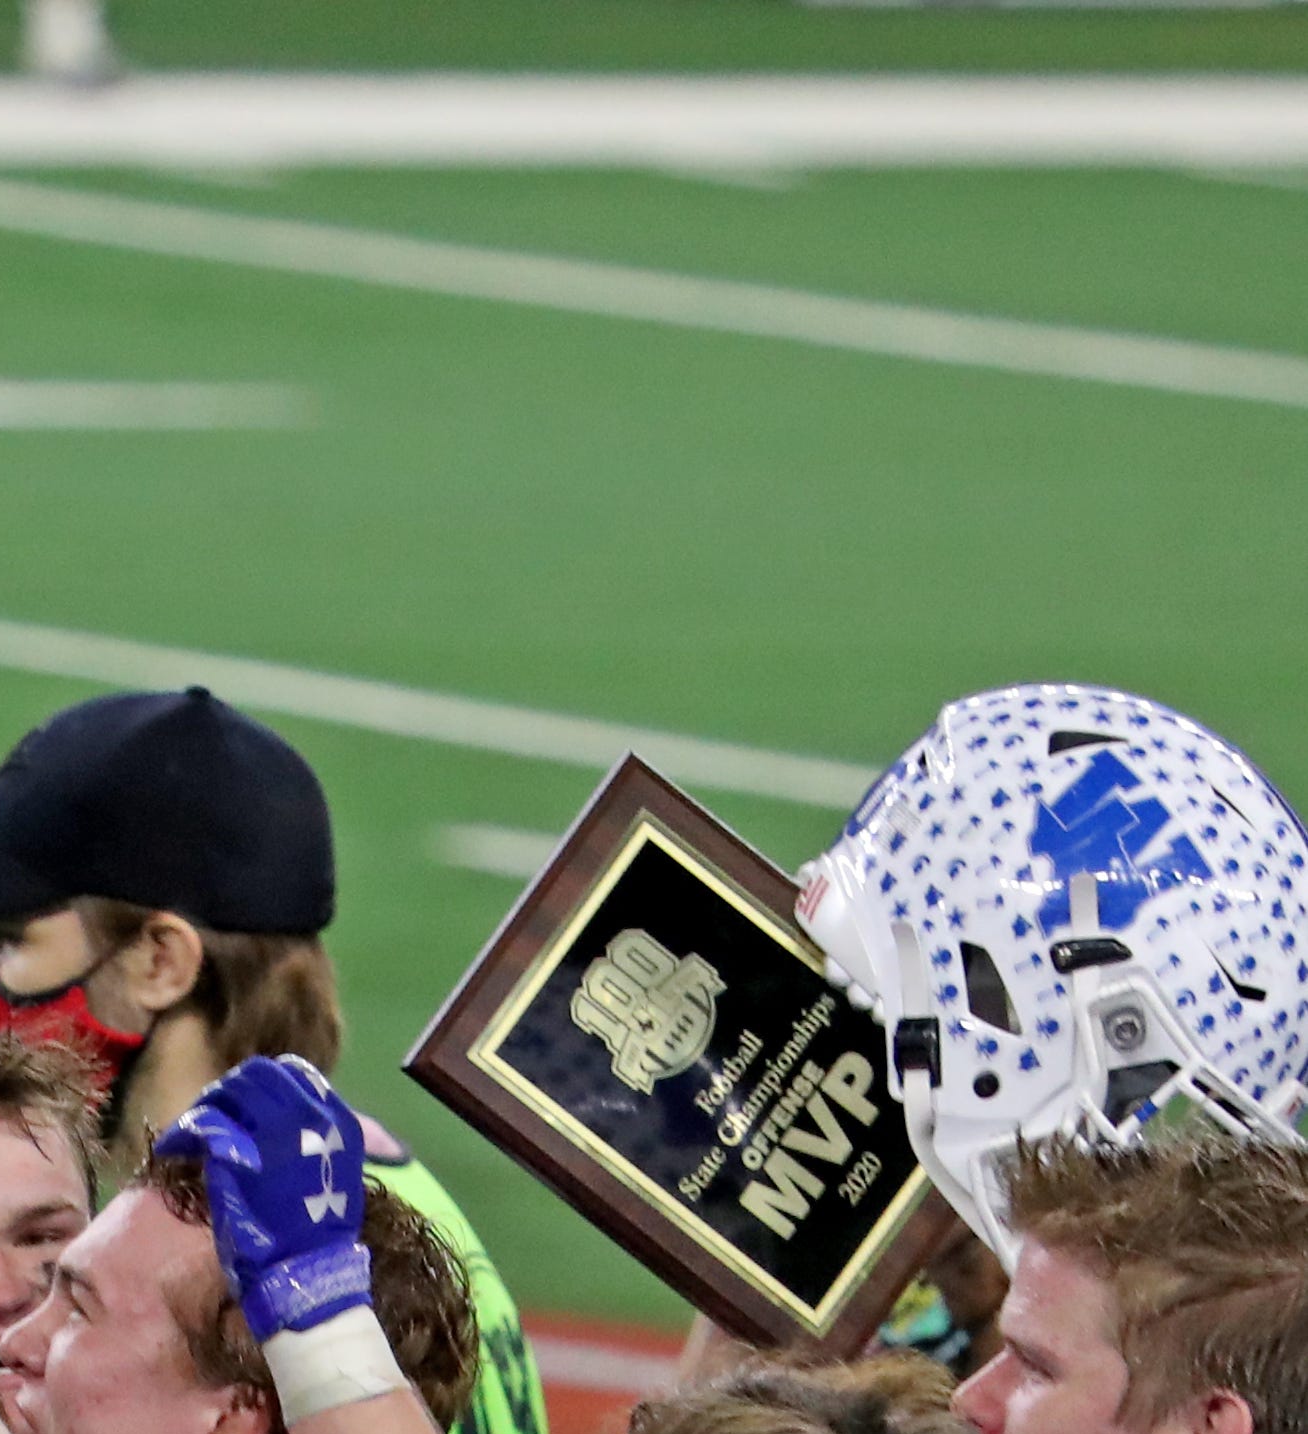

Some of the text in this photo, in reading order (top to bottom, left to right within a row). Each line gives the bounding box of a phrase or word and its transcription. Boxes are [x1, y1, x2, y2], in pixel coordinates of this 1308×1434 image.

[677, 1145, 728, 1203] State
[716, 991, 836, 1148] Championships
[693, 1027, 765, 1119] Football
[740, 1058, 827, 1172] OFFENSE
[738, 1050, 881, 1242] MVP
[837, 1149, 884, 1208] 2020
